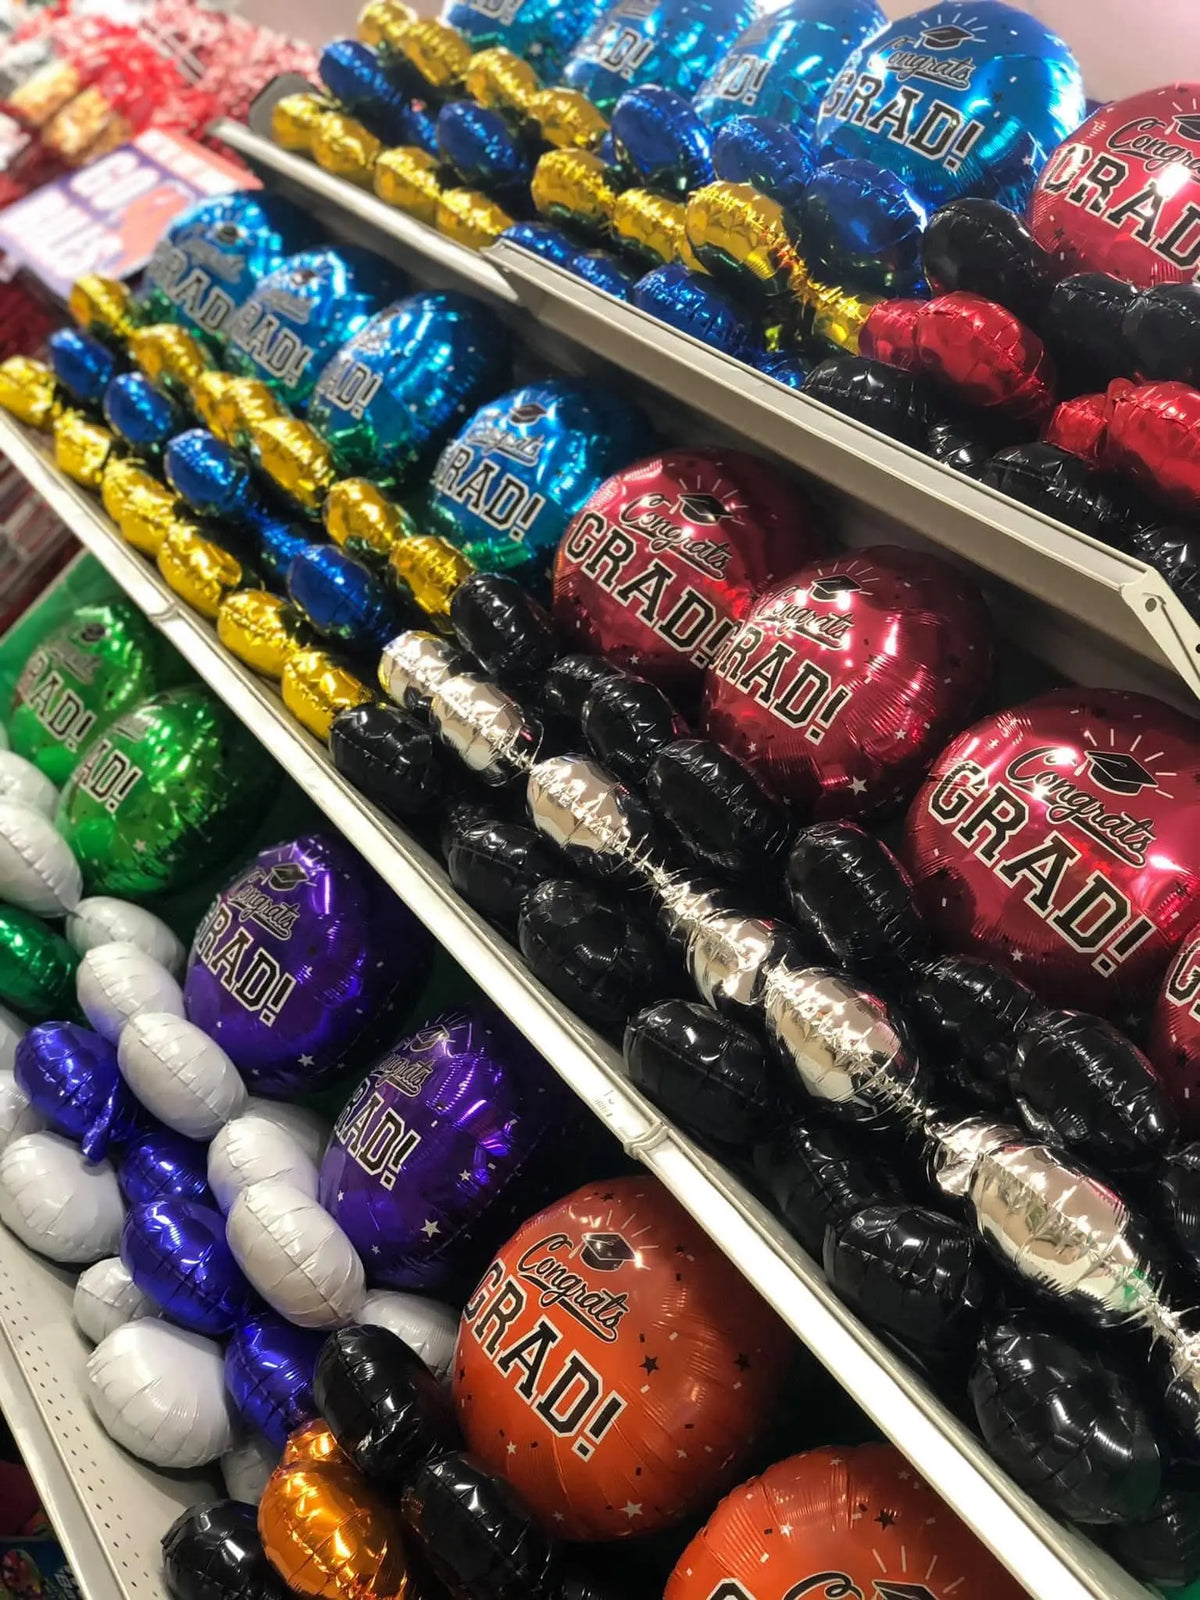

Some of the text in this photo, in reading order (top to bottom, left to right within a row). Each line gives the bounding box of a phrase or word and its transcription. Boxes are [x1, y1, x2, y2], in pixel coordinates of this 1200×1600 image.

[1106, 116, 1200, 185] Congr
[1042, 142, 1200, 287] GRAD
[431, 443, 547, 542] RAD!
[619, 493, 732, 582] Congrats
[565, 510, 740, 670] GRAD!
[1006, 746, 1157, 868] Congrats
[928, 760, 1157, 978] GRAD!
[334, 1076, 422, 1191] RAD!
[516, 1232, 630, 1343] Congrats
[462, 1257, 628, 1463] GRAD!
